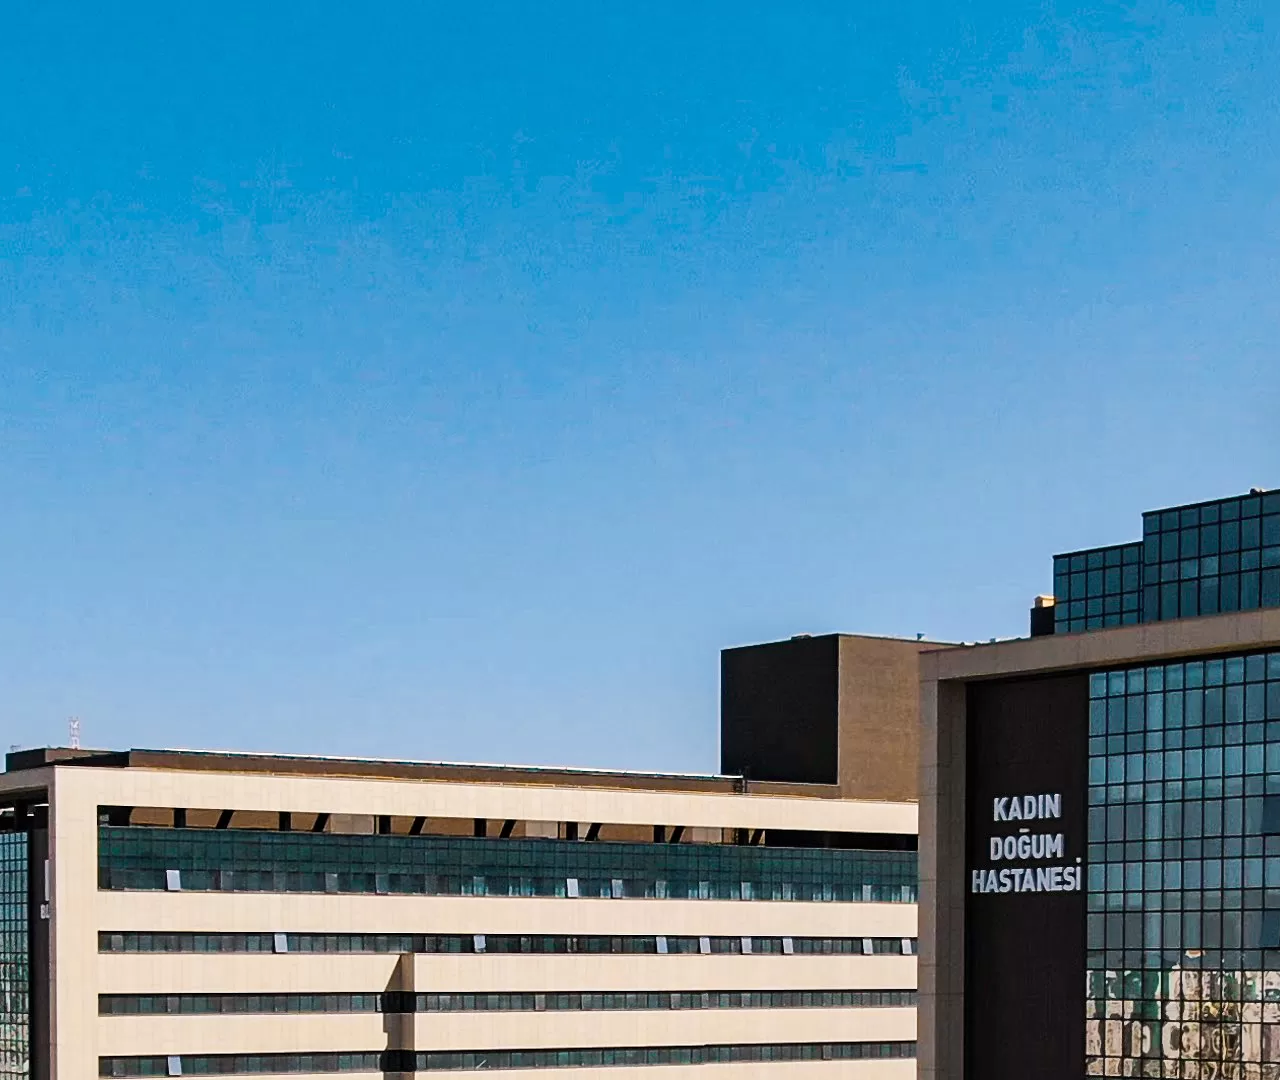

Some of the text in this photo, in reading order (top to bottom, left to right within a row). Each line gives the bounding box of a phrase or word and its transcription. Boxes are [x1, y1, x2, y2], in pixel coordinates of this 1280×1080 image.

[993, 793, 1061, 822] KADIN
[990, 828, 1064, 861] DOĞUM
[972, 857, 1081, 893] HASTANESİ
